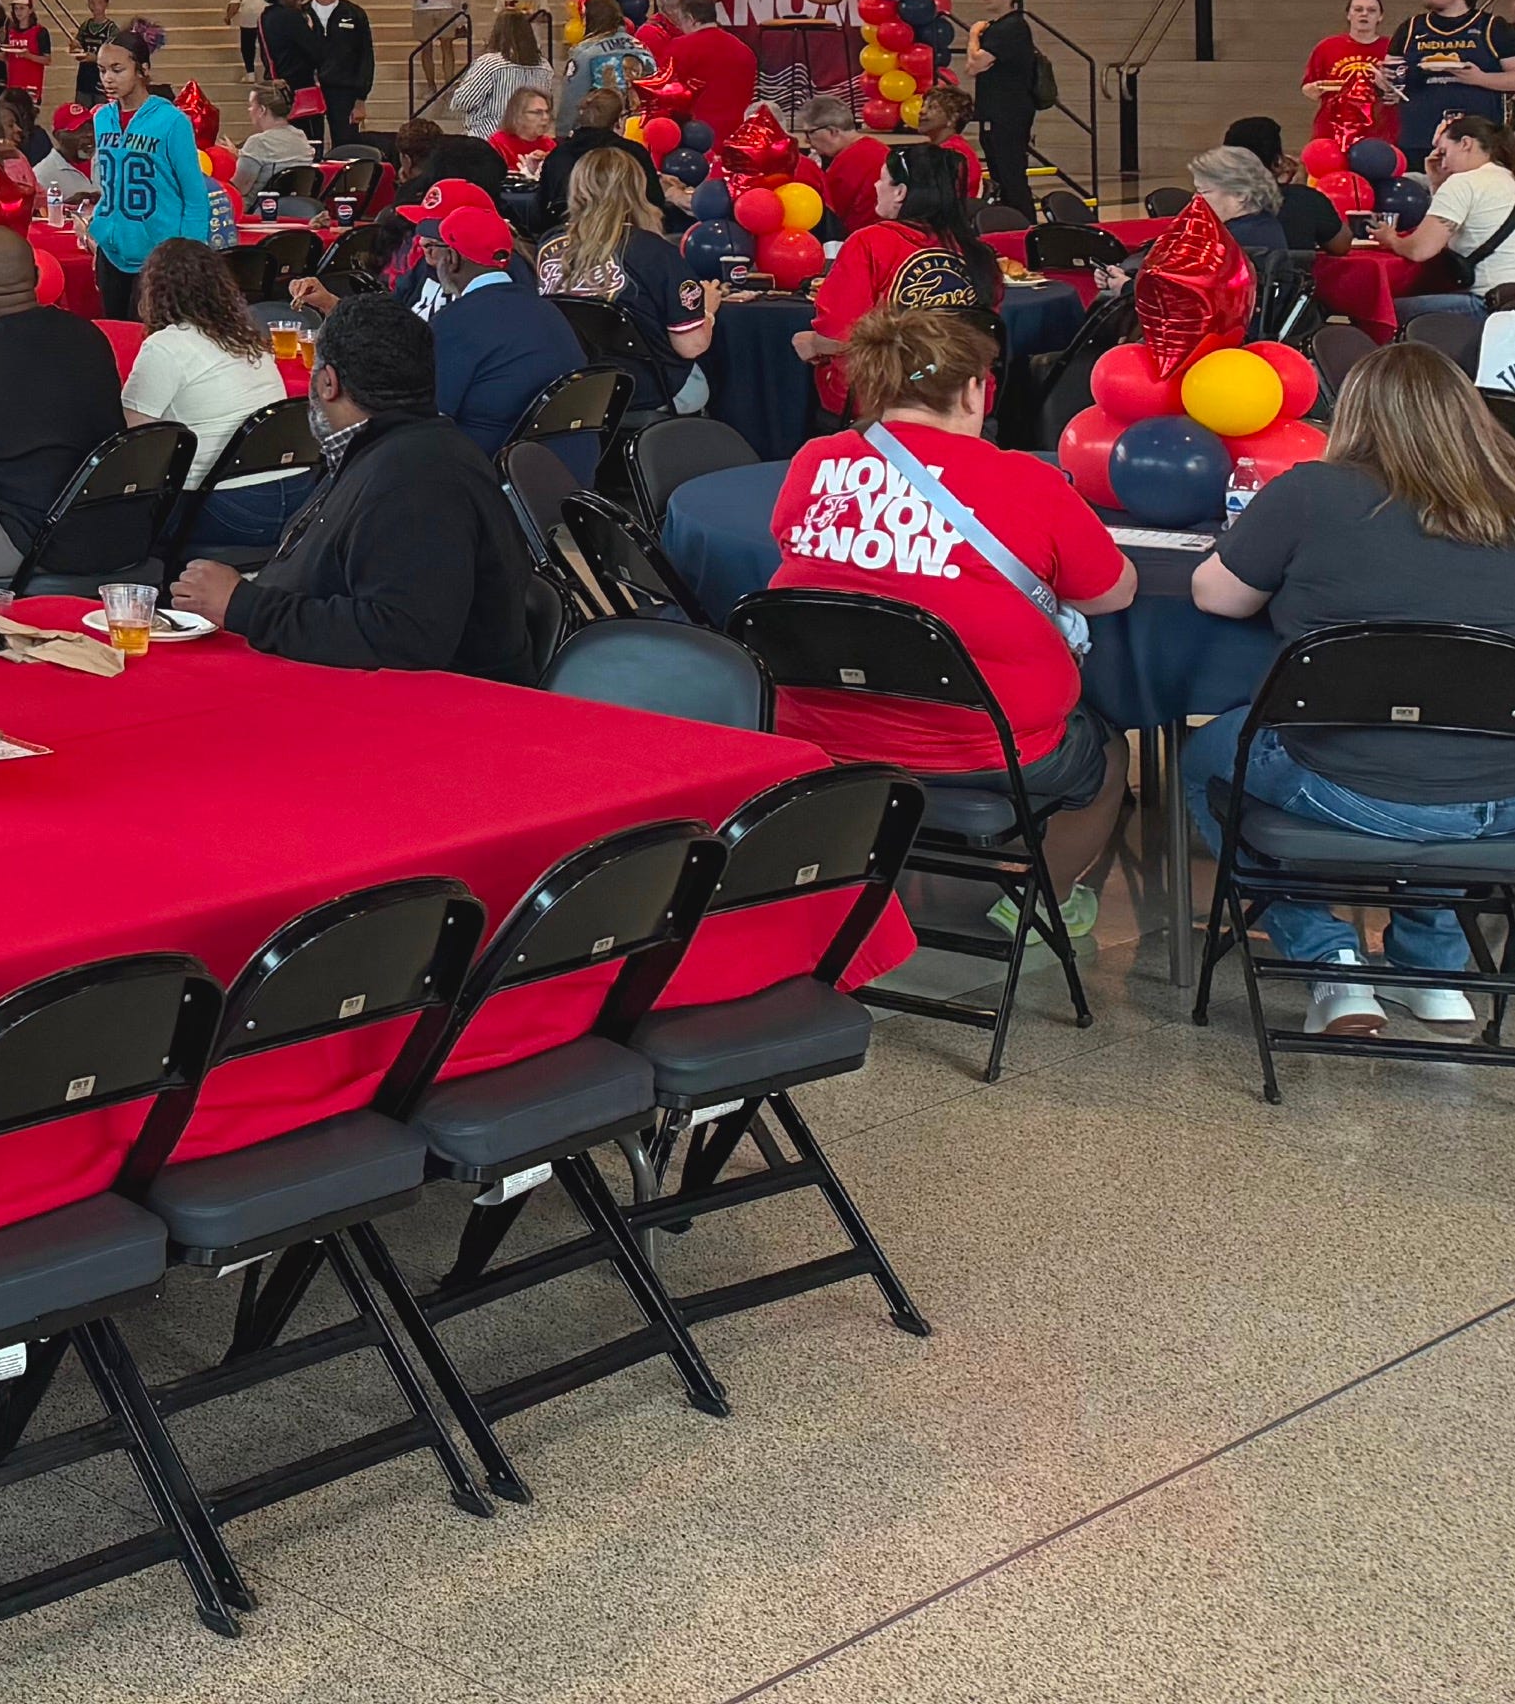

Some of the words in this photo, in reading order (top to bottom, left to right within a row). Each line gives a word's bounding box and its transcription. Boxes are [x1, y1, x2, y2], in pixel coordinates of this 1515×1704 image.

[1416, 39, 1477, 51] INDIANA
[122, 132, 161, 154] PINK
[810, 456, 945, 502] NOW
[856, 491, 975, 546] YOU
[790, 525, 961, 580] KNOW.
